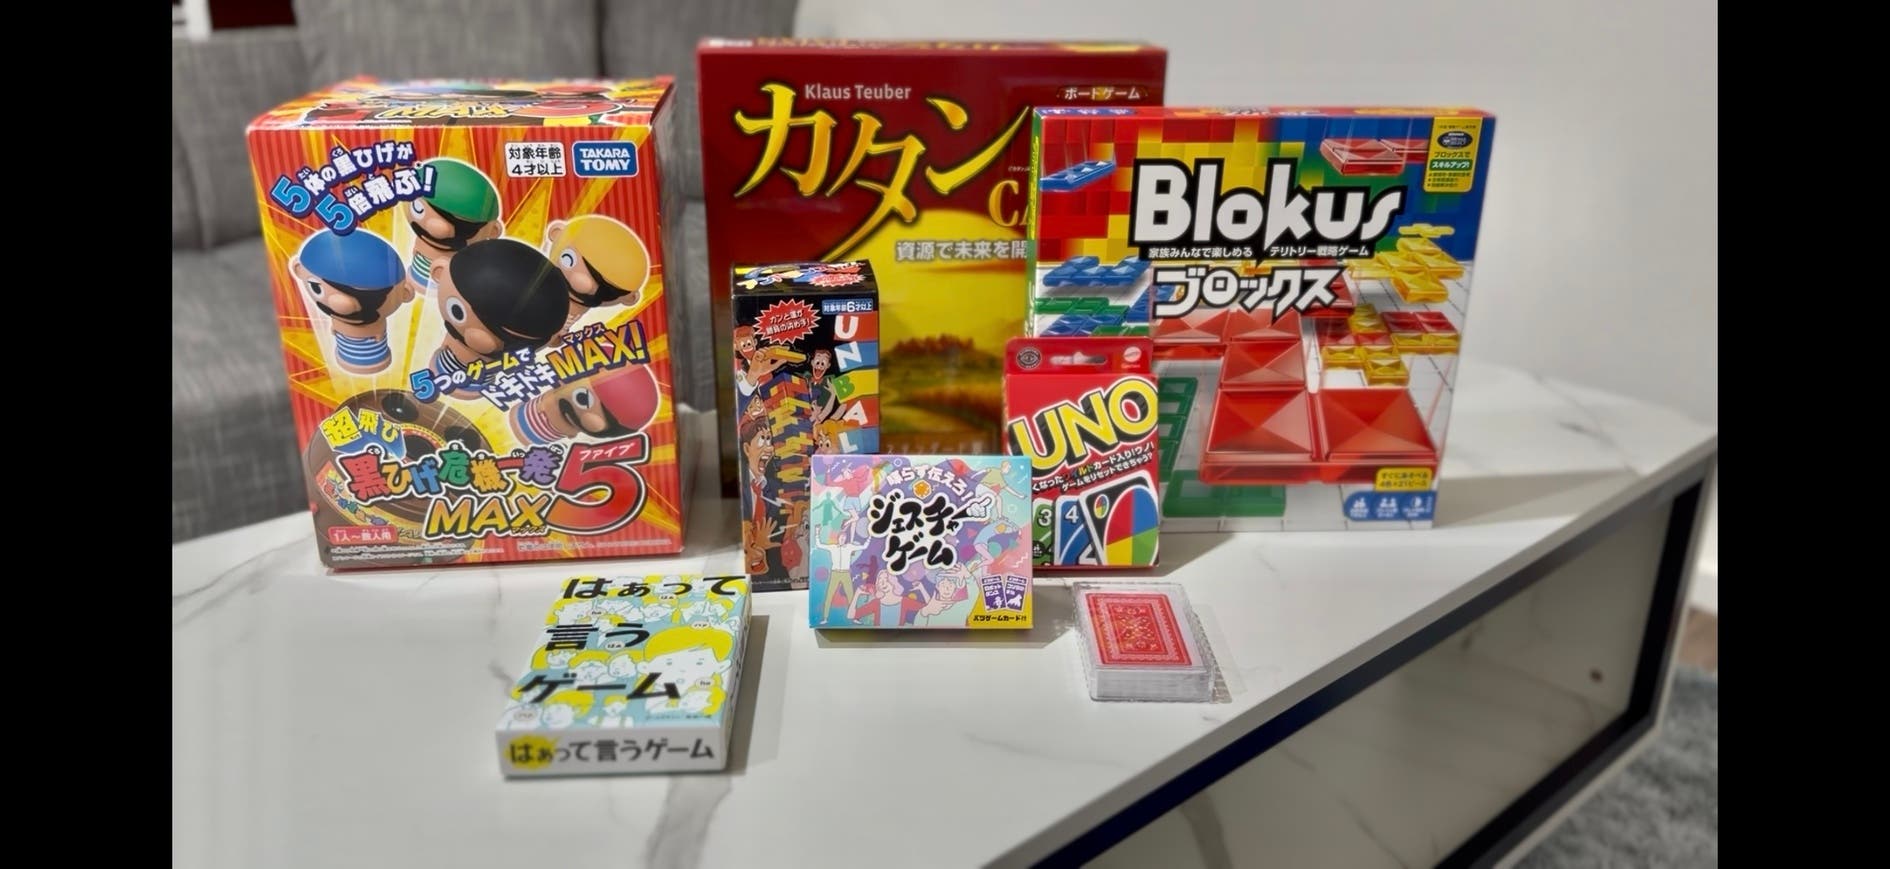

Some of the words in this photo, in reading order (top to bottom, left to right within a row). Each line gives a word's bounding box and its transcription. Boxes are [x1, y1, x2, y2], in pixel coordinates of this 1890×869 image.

[805, 84, 851, 100] Klaus
[855, 84, 911, 100] Teuber
[1065, 87, 1140, 100] ボードゲーム
[509, 147, 562, 160] 対象年齢
[579, 148, 631, 159] TAKARA
[512, 163, 563, 175] 4才以上
[580, 160, 631, 171] TOMY
[734, 84, 1029, 262] カタン
[1134, 163, 1401, 251] Blokus
[1148, 247, 1253, 258] 家族みんなで楽しめる
[1270, 246, 1369, 257] テリトリー戦略ゲーム
[1154, 266, 1339, 318] ブロックス
[564, 324, 604, 344] マックス
[1008, 376, 1158, 470] UNO
[579, 443, 636, 461] ファイブ
[426, 496, 549, 535] MAX
[546, 434, 645, 530] 5
[1038, 509, 1052, 526] 3
[1065, 505, 1079, 523] 4
[886, 531, 954, 571] ゲーム
[546, 623, 649, 651] 言う
[518, 672, 680, 703] ゲーム
[509, 738, 715, 763] はぁって言うゲーム
